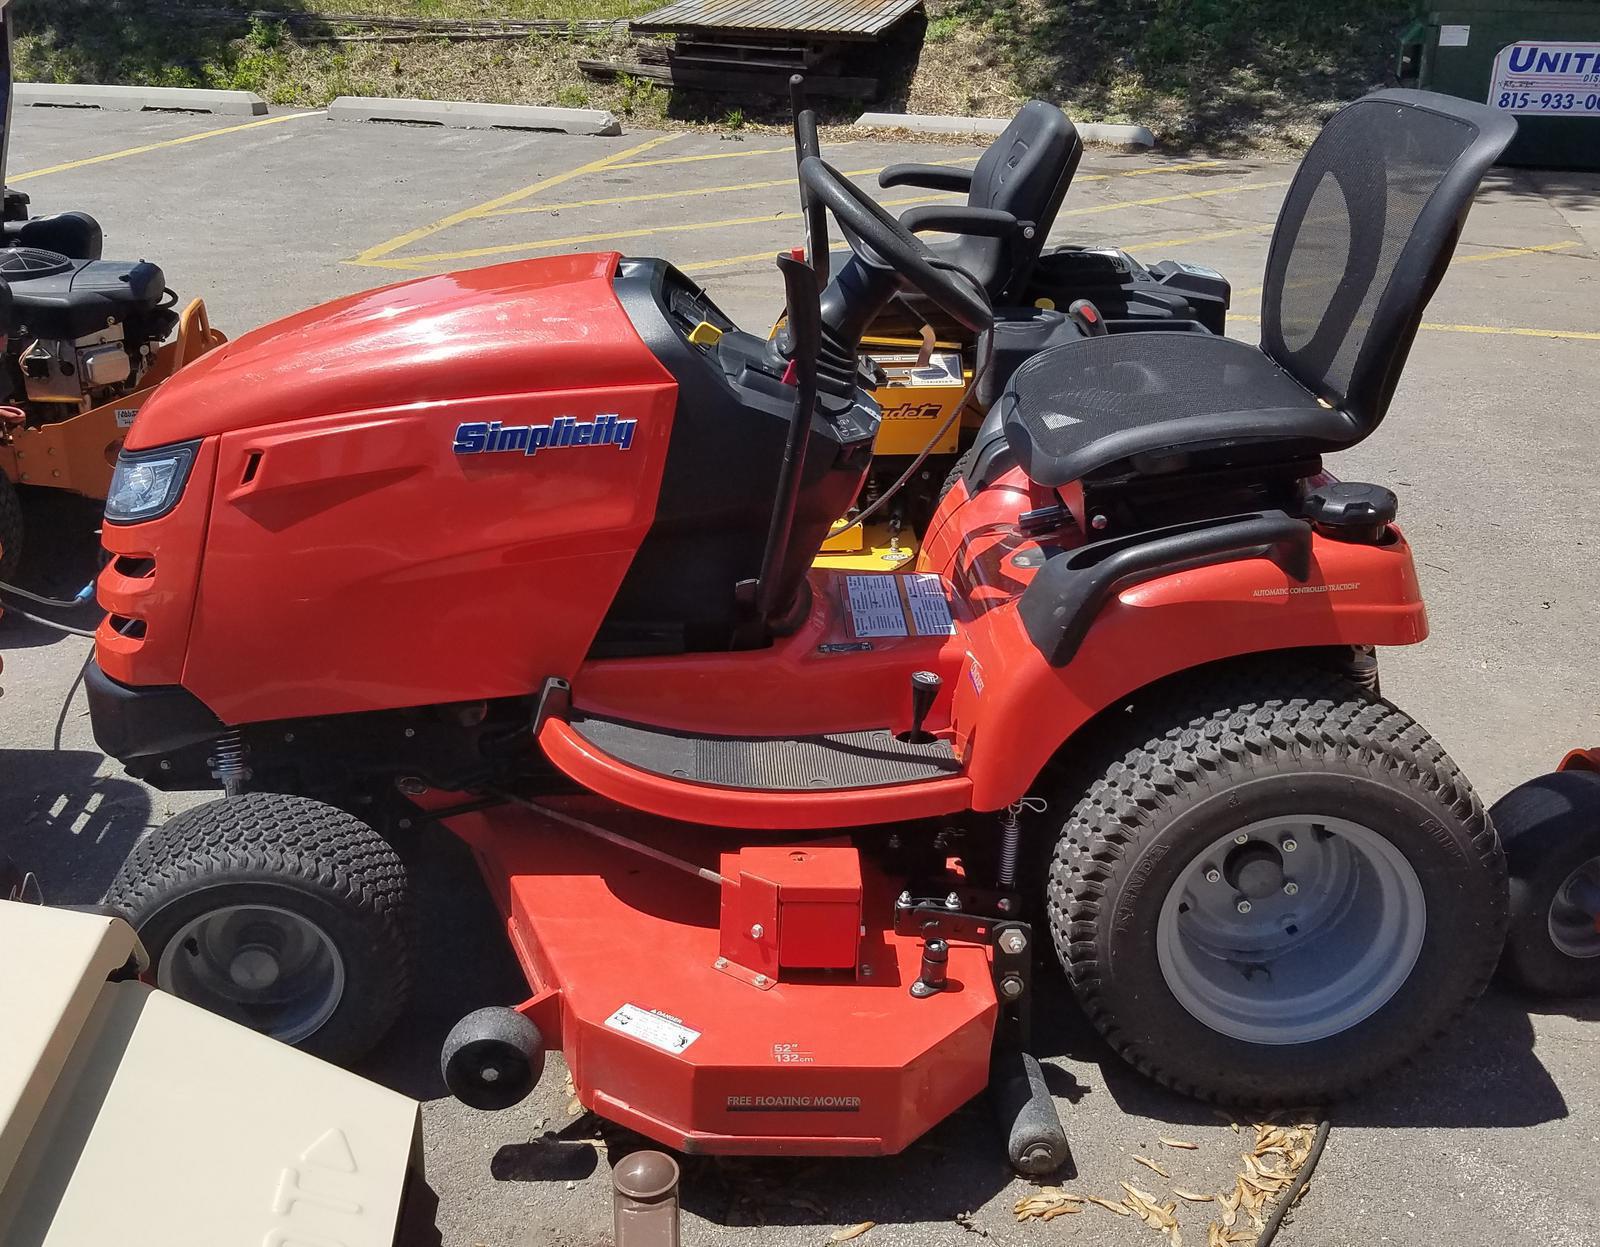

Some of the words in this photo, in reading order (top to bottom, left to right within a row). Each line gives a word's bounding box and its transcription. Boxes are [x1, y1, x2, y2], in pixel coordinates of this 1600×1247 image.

[1583, 74, 1600, 83] DIS
[1498, 92, 1600, 110] 815-933-0
[878, 403, 943, 420] adet
[453, 414, 638, 457] Simplicity
[1252, 588, 1289, 597] AUTOMATIC
[1289, 585, 1328, 595] CONTROLLED
[656, 1009, 684, 1025] DANGER
[727, 1096, 752, 1106] FREE
[755, 1096, 810, 1106] FLOATING
[813, 1096, 861, 1107] MOWER
